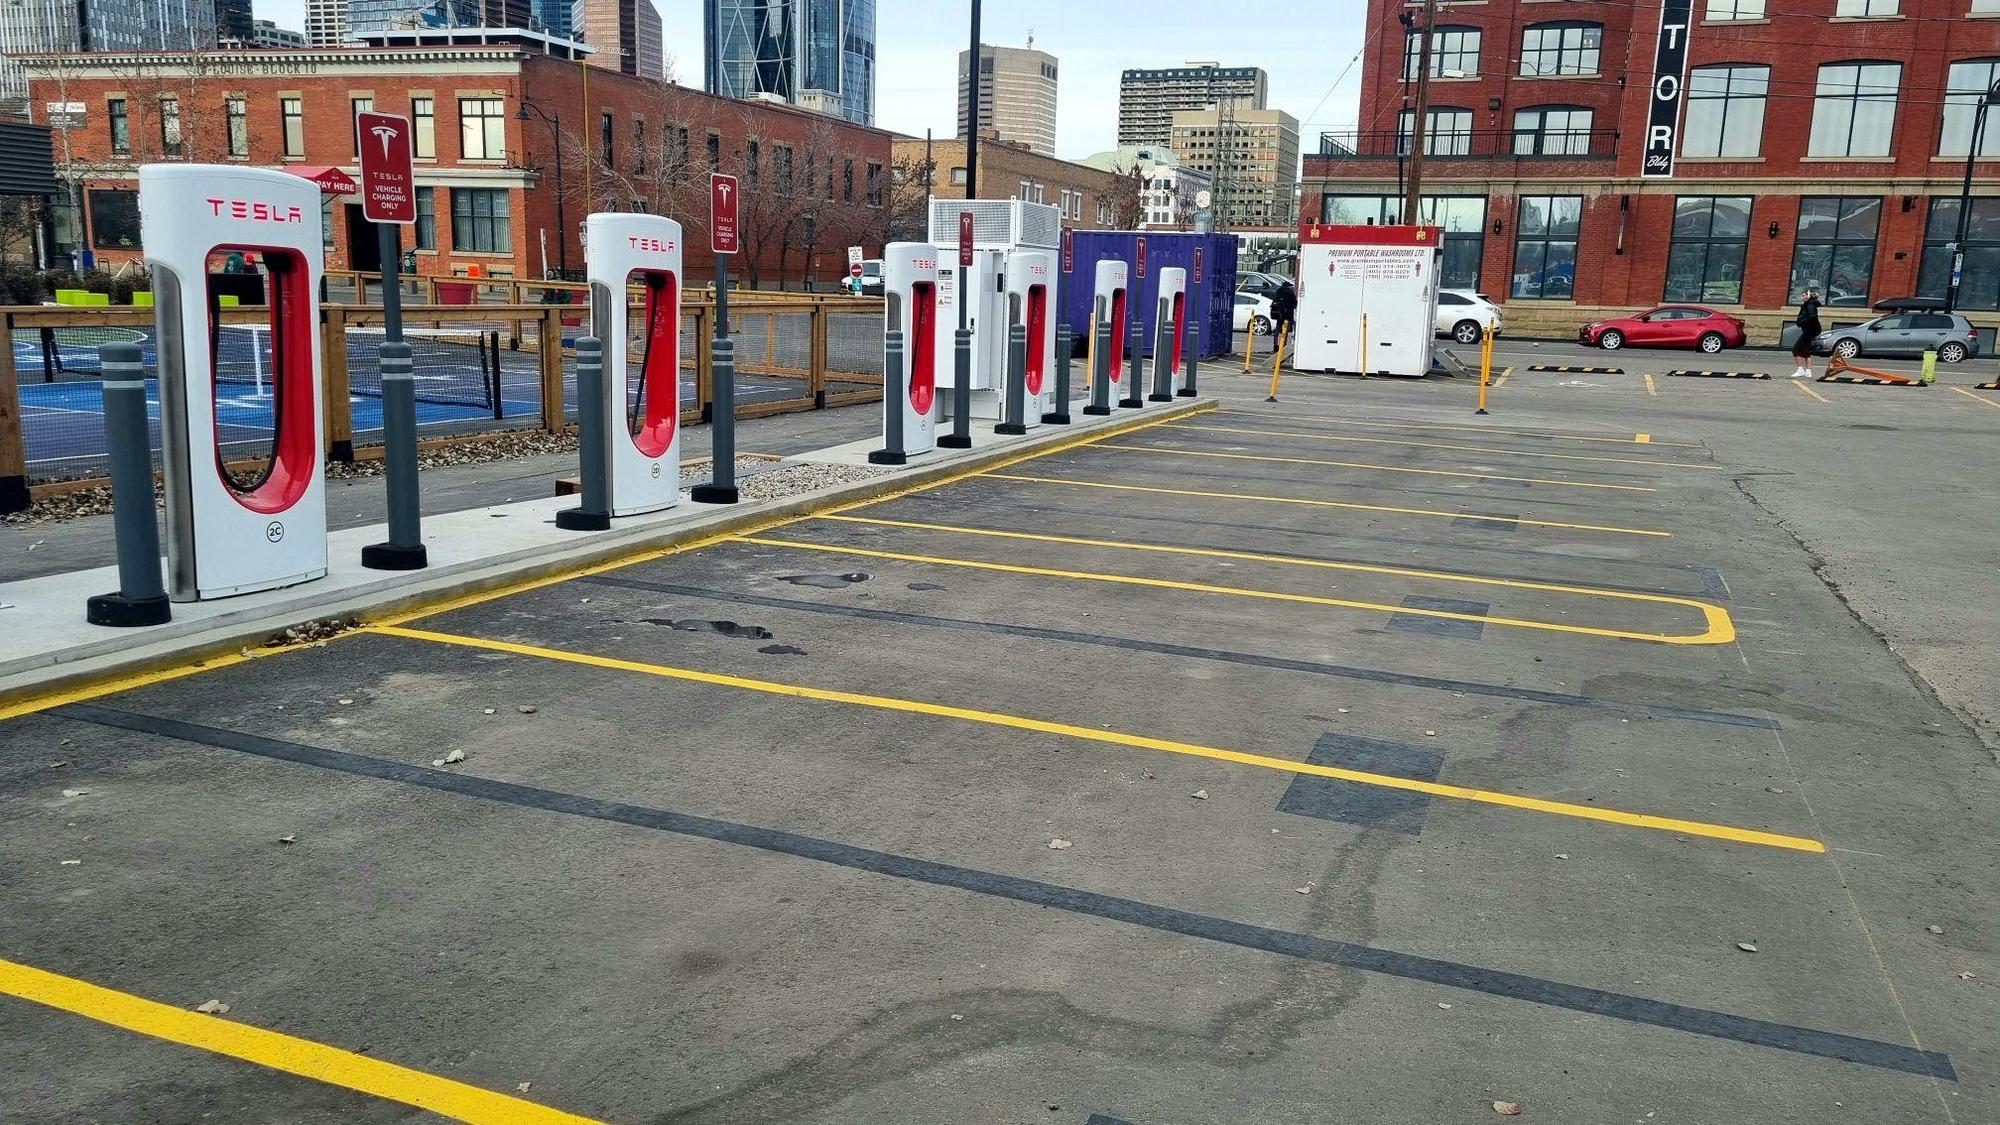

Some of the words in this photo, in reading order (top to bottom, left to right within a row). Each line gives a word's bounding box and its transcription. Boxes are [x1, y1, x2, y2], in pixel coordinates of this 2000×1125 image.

[262, 63, 300, 74] BLOCK
[1646, 155, 1669, 171] Bldg
[372, 171, 404, 181] TESLA
[317, 180, 331, 190] PAY
[333, 182, 355, 192] HERE
[375, 184, 403, 193] VEHICLE
[372, 193, 407, 202] CHARGING
[381, 201, 399, 209] ONLY
[206, 199, 302, 223] TESLA
[628, 237, 675, 253] TESLA
[1328, 249, 1353, 257] PREMIUM
[1353, 249, 1380, 257] PORTABLE
[269, 526, 282, 537] 2C
